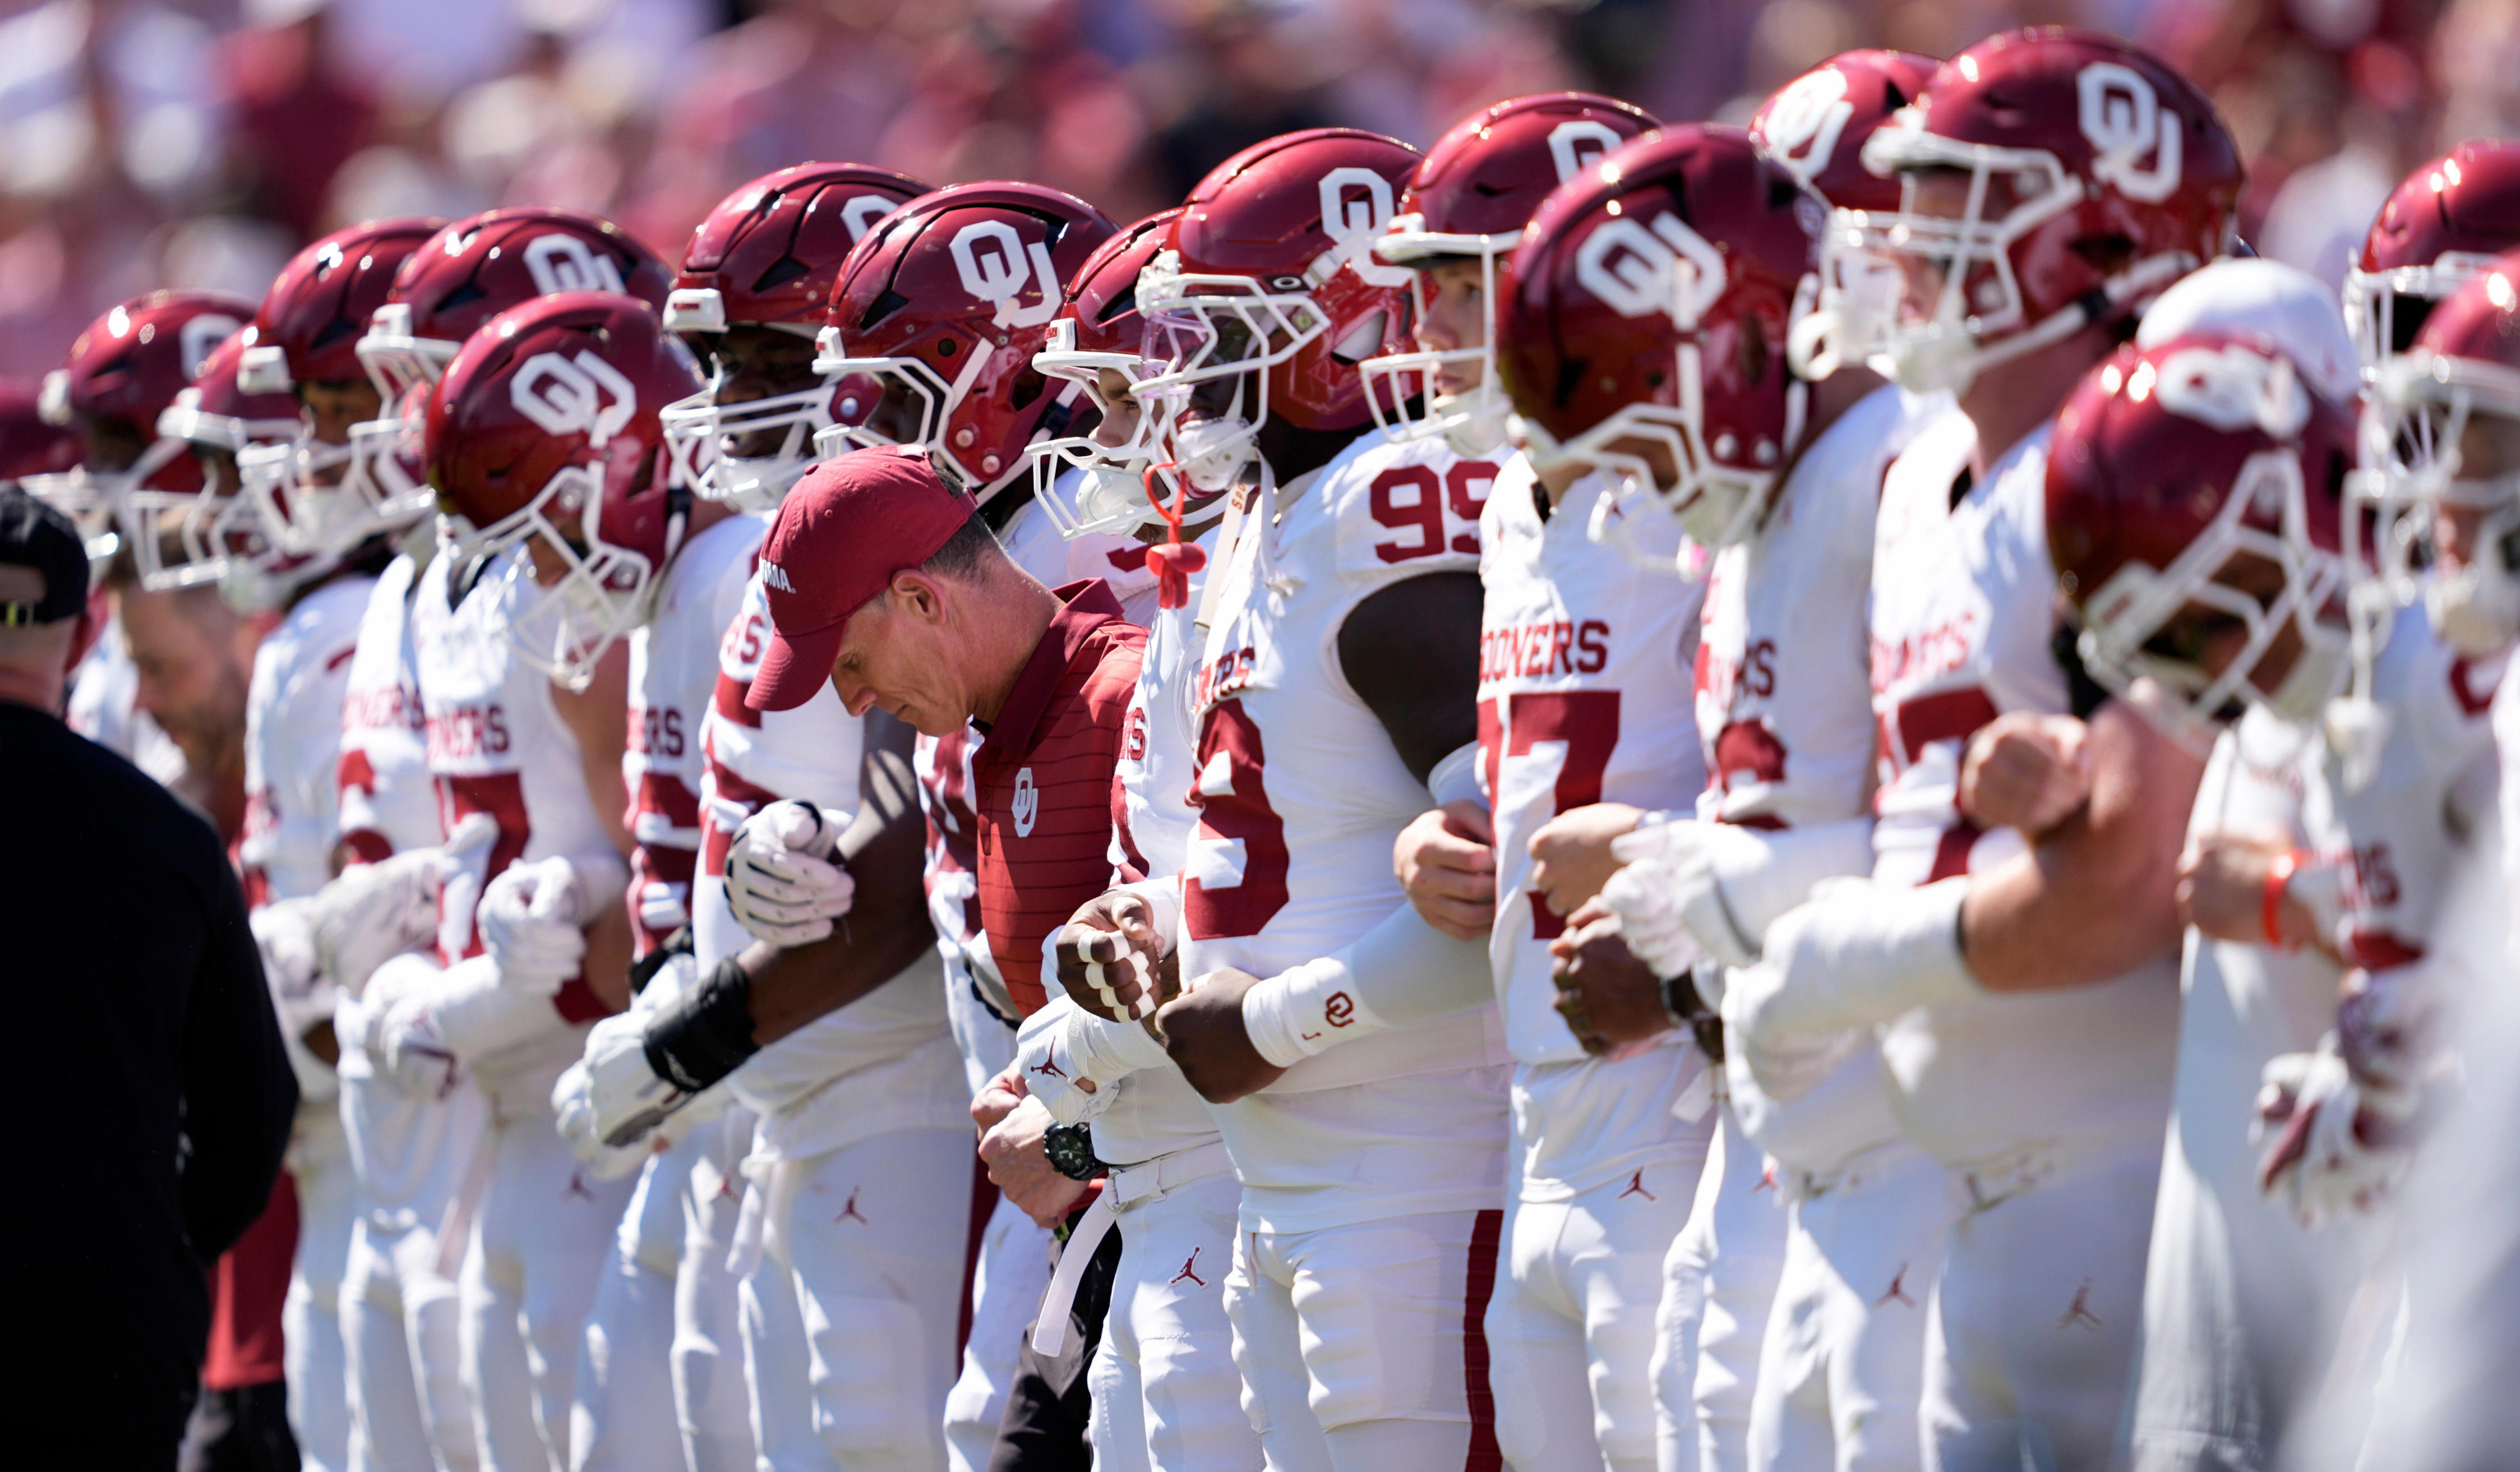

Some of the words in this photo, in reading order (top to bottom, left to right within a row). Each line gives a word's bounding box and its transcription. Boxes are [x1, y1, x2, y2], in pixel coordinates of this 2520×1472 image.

[2076, 61, 2182, 204] OU
[949, 220, 1062, 327] OU
[1576, 211, 1727, 317] OU
[511, 349, 636, 436] OU
[1012, 767, 1039, 838] OU
[1326, 991, 1355, 1028] OU
